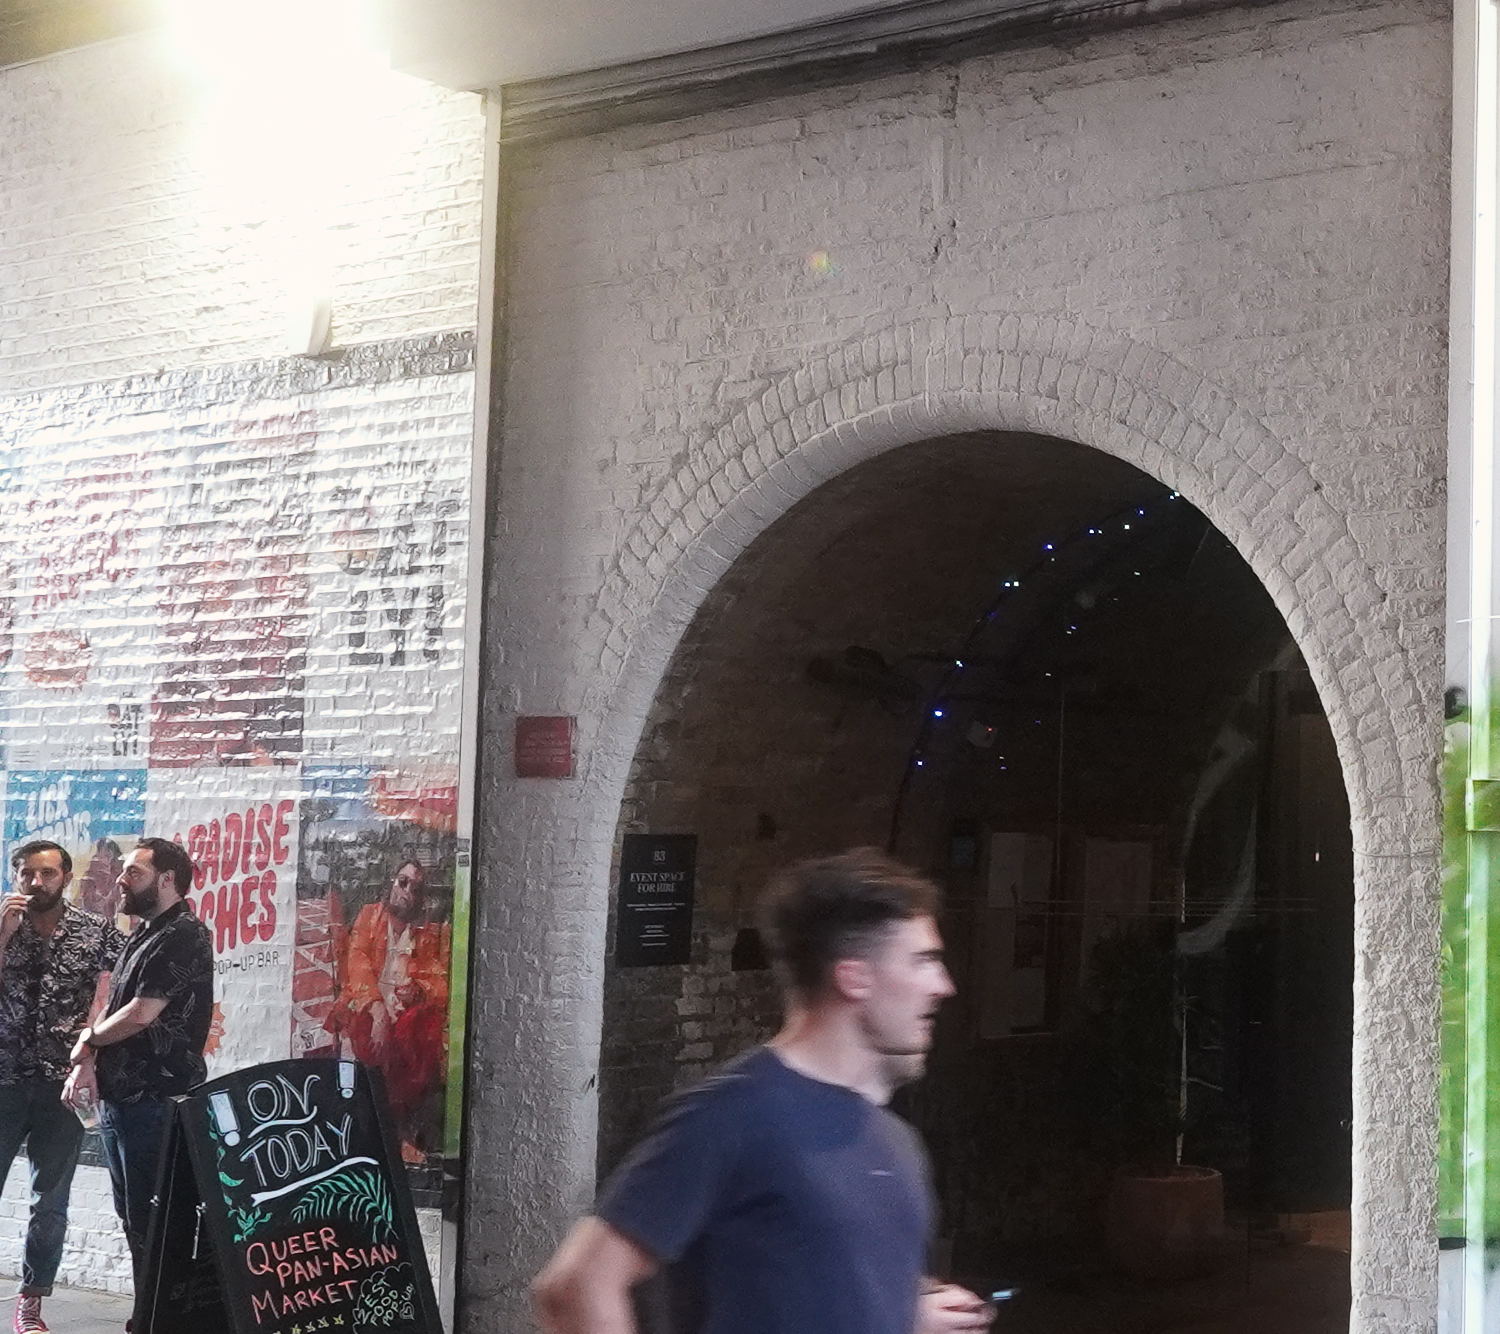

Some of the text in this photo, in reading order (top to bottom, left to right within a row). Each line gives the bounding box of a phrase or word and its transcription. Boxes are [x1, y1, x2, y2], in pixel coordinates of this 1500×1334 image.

[174, 799, 295, 892] RADISE
[630, 872, 685, 882] EVENT SPACE
[638, 882, 676, 893] FOR HIRE
[185, 870, 277, 955] CHES
[257, 951, 281, 968] BAR
[246, 1074, 320, 1123] ON
[240, 1113, 354, 1187] TODAY
[246, 1227, 339, 1275] QUEER
[276, 1243, 398, 1288] PAN-ASIAN
[251, 1279, 359, 1325] MARKET
[370, 1289, 399, 1327] FOOD
